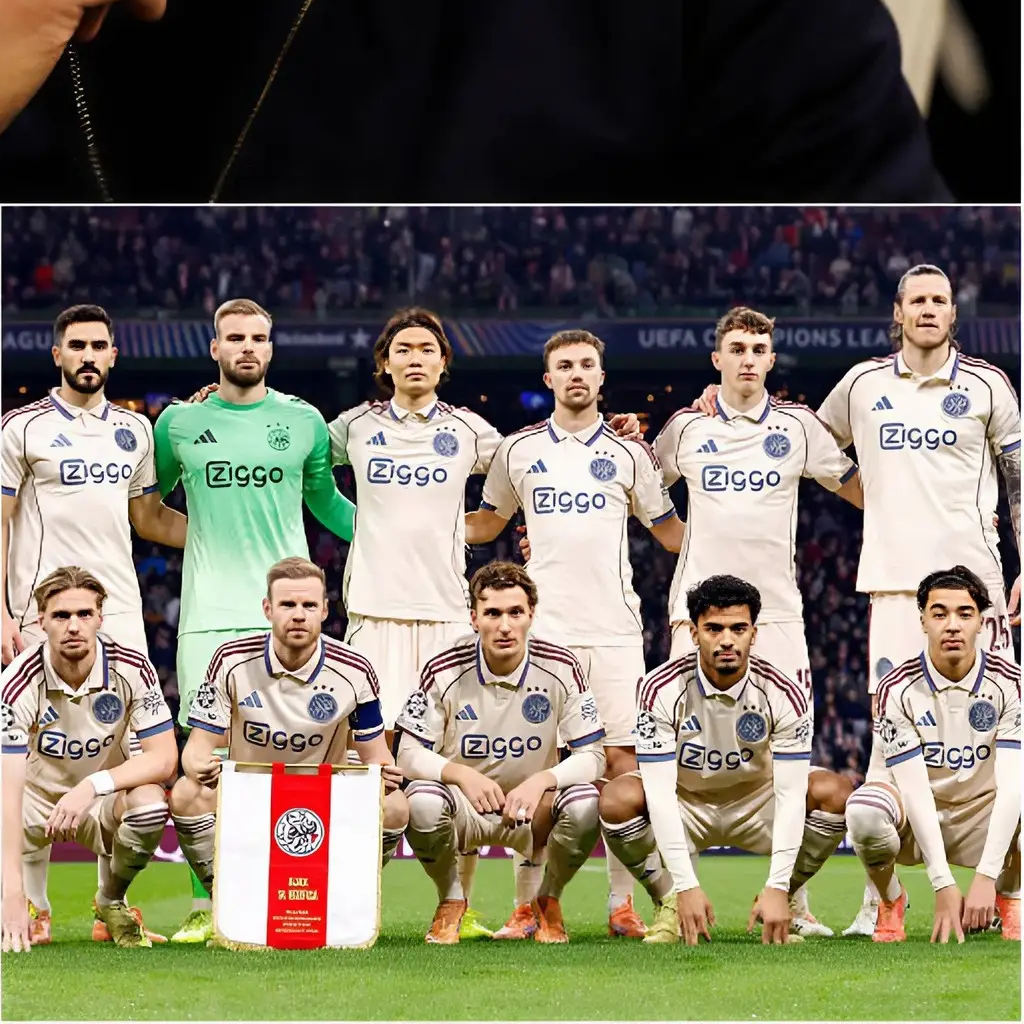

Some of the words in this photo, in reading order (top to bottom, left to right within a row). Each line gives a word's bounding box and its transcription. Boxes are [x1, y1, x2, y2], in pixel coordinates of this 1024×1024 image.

[639, 329, 697, 348] UEFA
[880, 423, 957, 450] Ziggo
[60, 459, 132, 485] Ziggo
[206, 461, 283, 488] Ziggo
[367, 458, 447, 486] Ziggo
[702, 465, 780, 492] Ziggo
[533, 487, 606, 514] Ziggo
[38, 730, 114, 759] Ziggo
[244, 721, 323, 752] Ziggo
[461, 734, 542, 759] Ziggo
